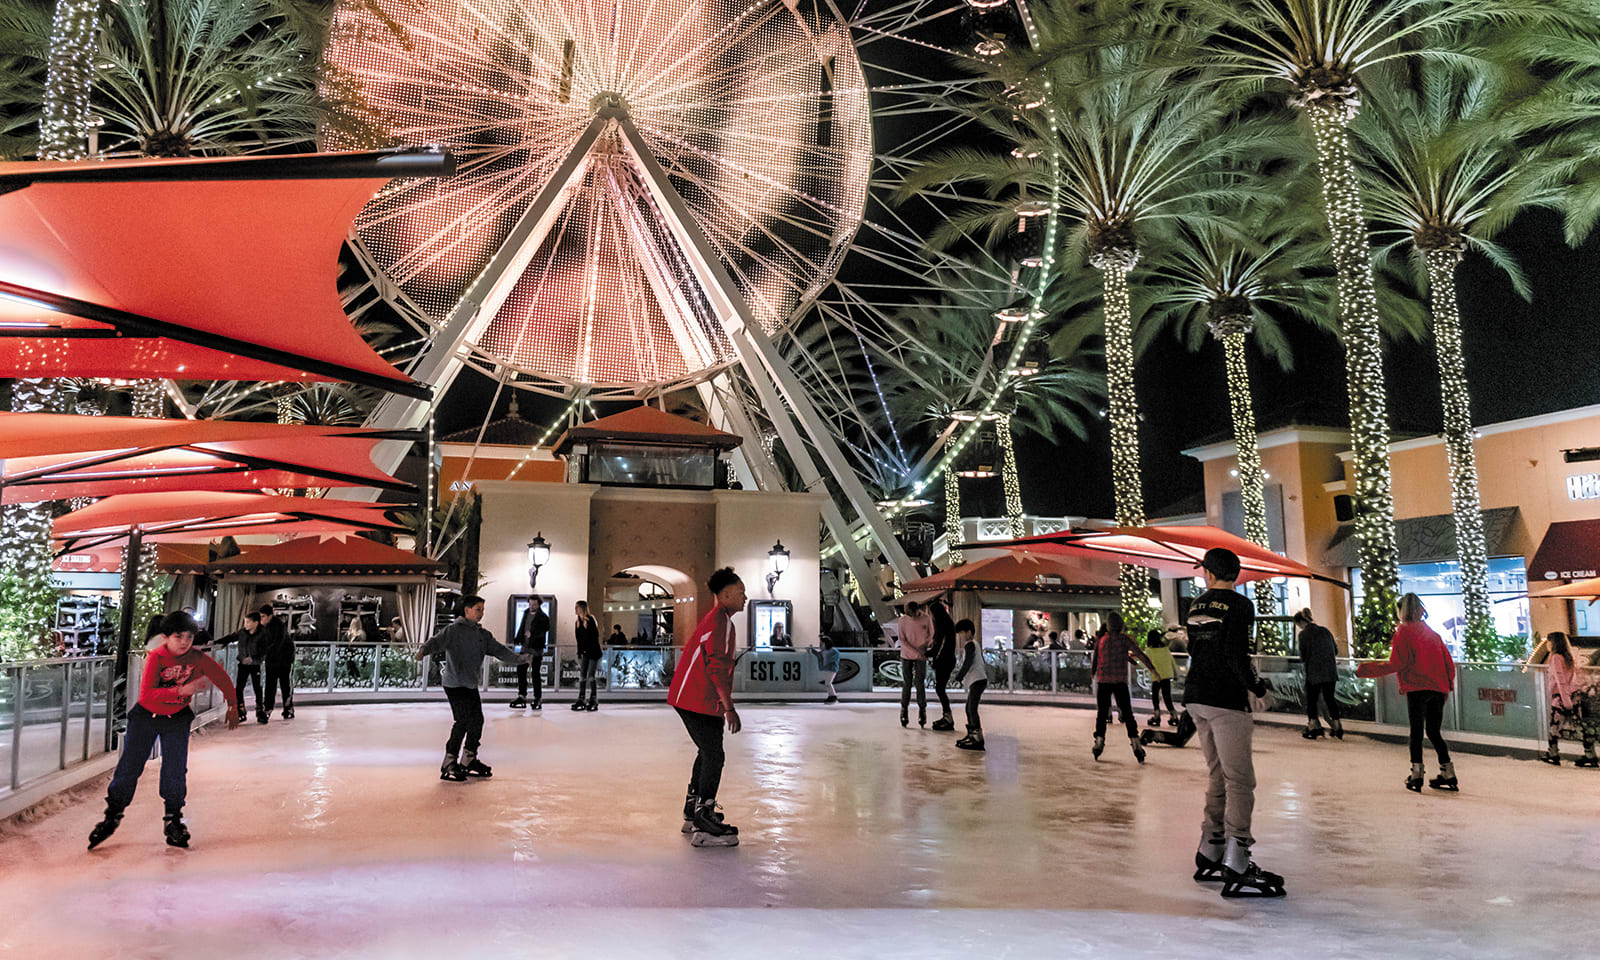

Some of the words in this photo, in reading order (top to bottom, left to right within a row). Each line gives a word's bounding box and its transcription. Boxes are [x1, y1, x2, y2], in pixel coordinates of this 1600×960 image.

[1572, 570, 1597, 578] CREAM
[750, 661, 779, 681] EST.
[782, 661, 801, 681] 93
